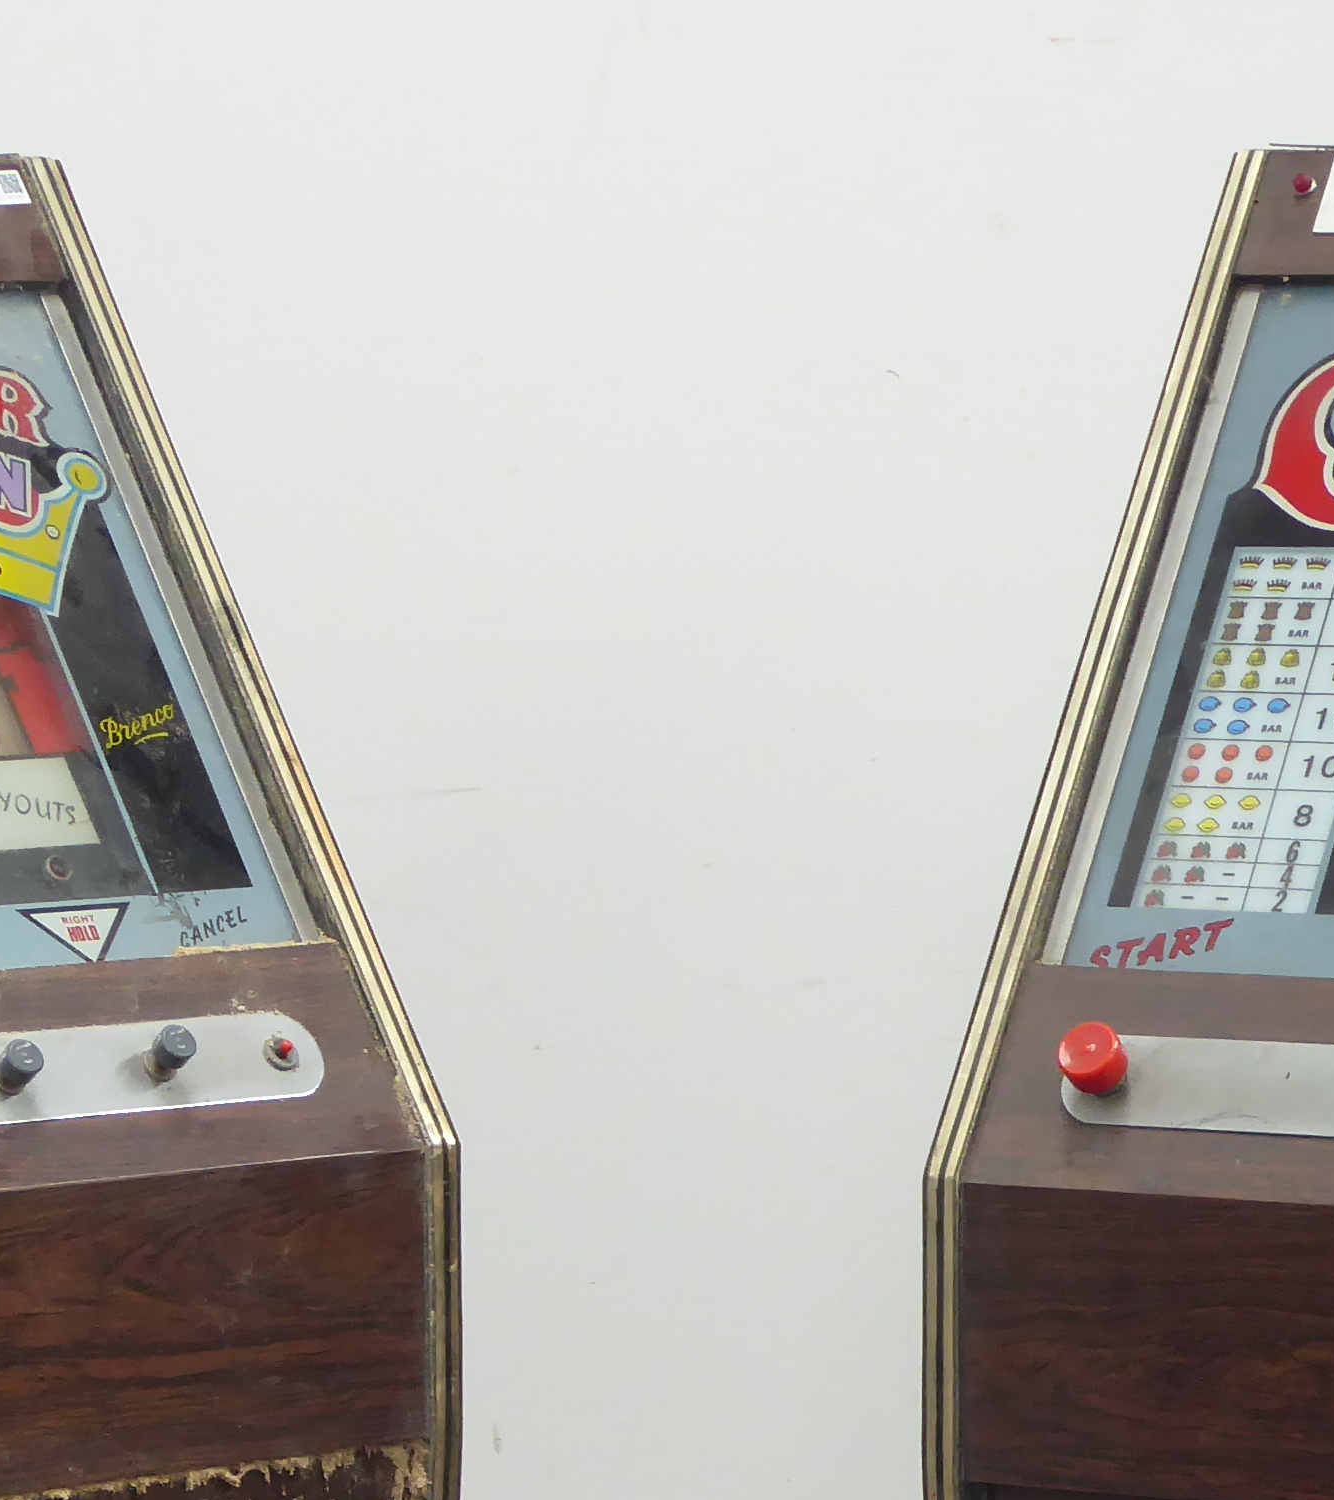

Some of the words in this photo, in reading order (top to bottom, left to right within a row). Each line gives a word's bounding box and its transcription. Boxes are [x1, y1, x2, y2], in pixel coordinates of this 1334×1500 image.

[1301, 581, 1323, 591] BAR
[1287, 628, 1310, 639] BAR
[1274, 676, 1297, 686] BAR
[99, 703, 175, 749] Brenco
[1260, 723, 1283, 734] BAR
[1246, 771, 1269, 782] BAR
[1231, 820, 1254, 831] BAR
[1293, 804, 1315, 828] 8
[1285, 840, 1302, 864] 6
[1279, 864, 1295, 891] 4
[1271, 890, 1289, 913] 2
[60, 914, 95, 925] RIGHT
[179, 905, 248, 948] CANCEL
[66, 924, 101, 943] HOLD
[1089, 918, 1235, 970] START
